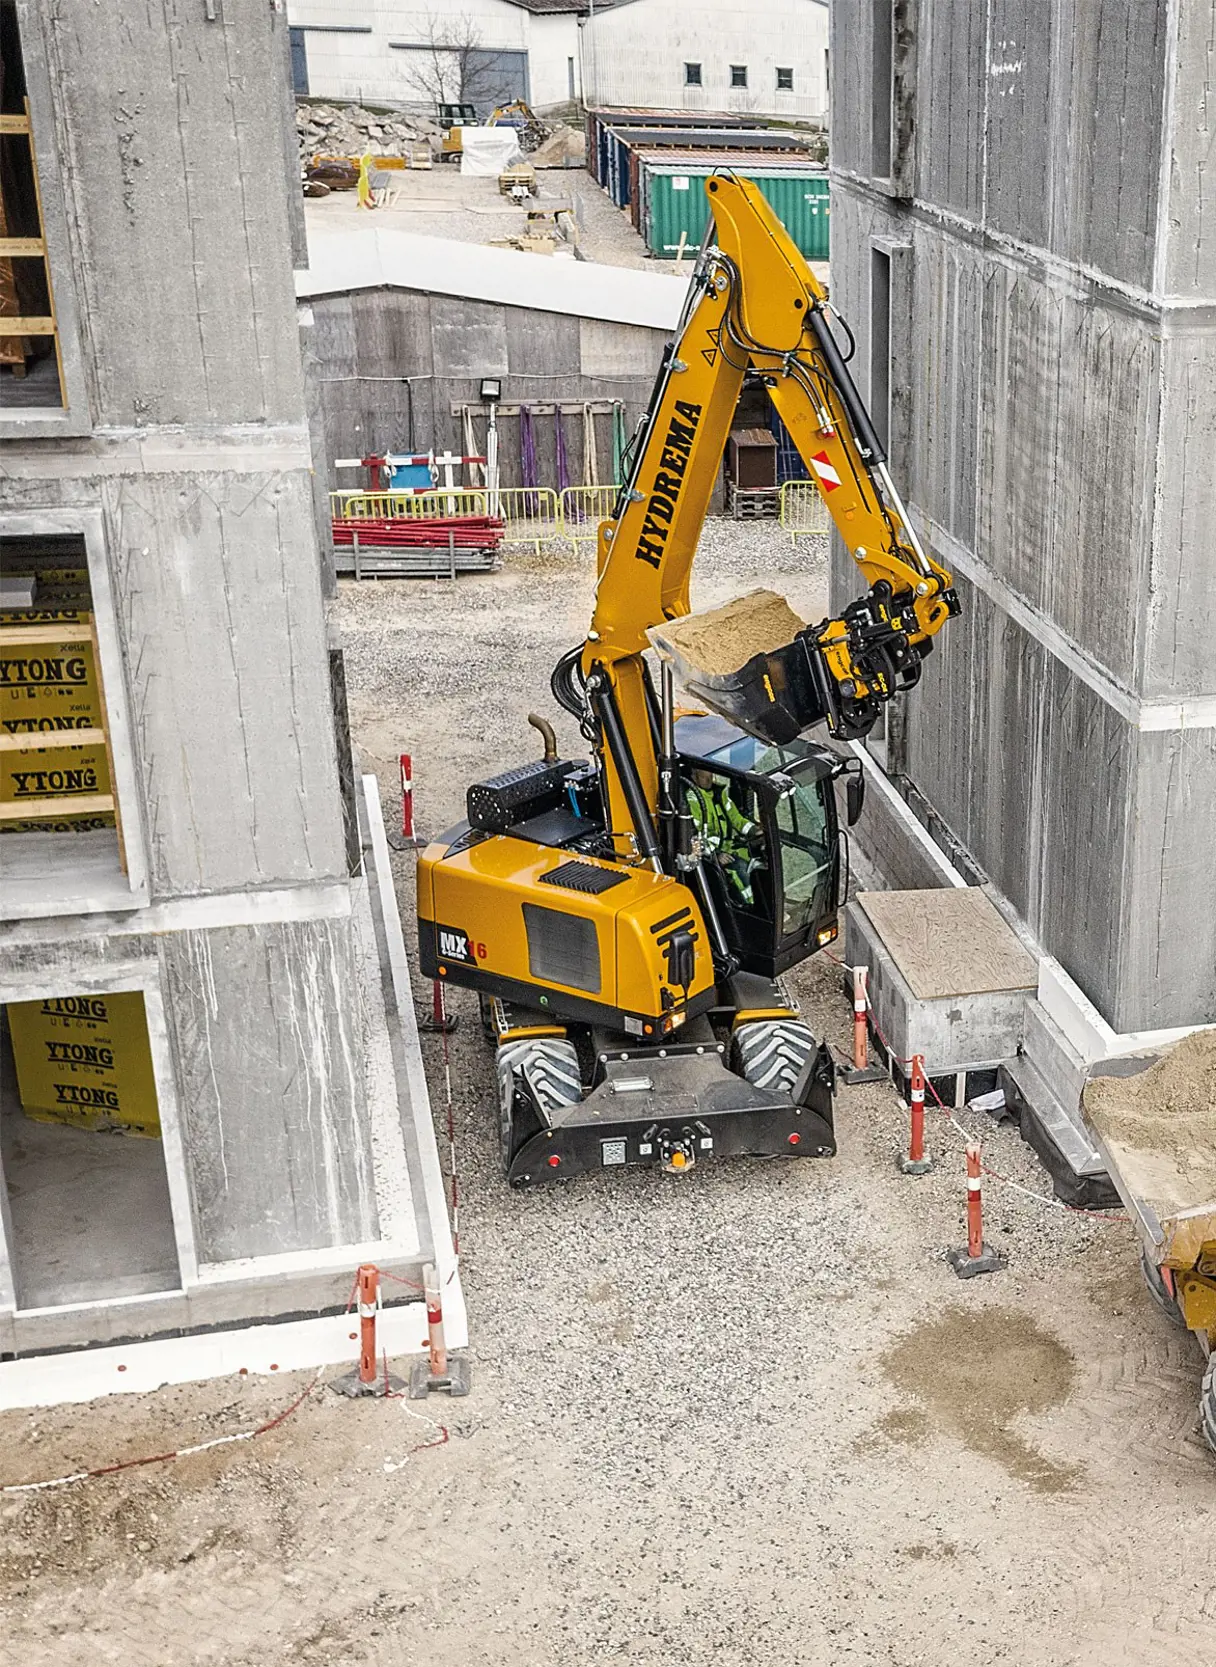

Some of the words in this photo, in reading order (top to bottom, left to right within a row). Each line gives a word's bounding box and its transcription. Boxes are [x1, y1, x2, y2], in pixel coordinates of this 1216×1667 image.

[635, 400, 702, 569] HYDREMA
[11, 768, 97, 792] YTONG
[45, 1041, 114, 1065] YTONG
[53, 1084, 119, 1106] YTONG
